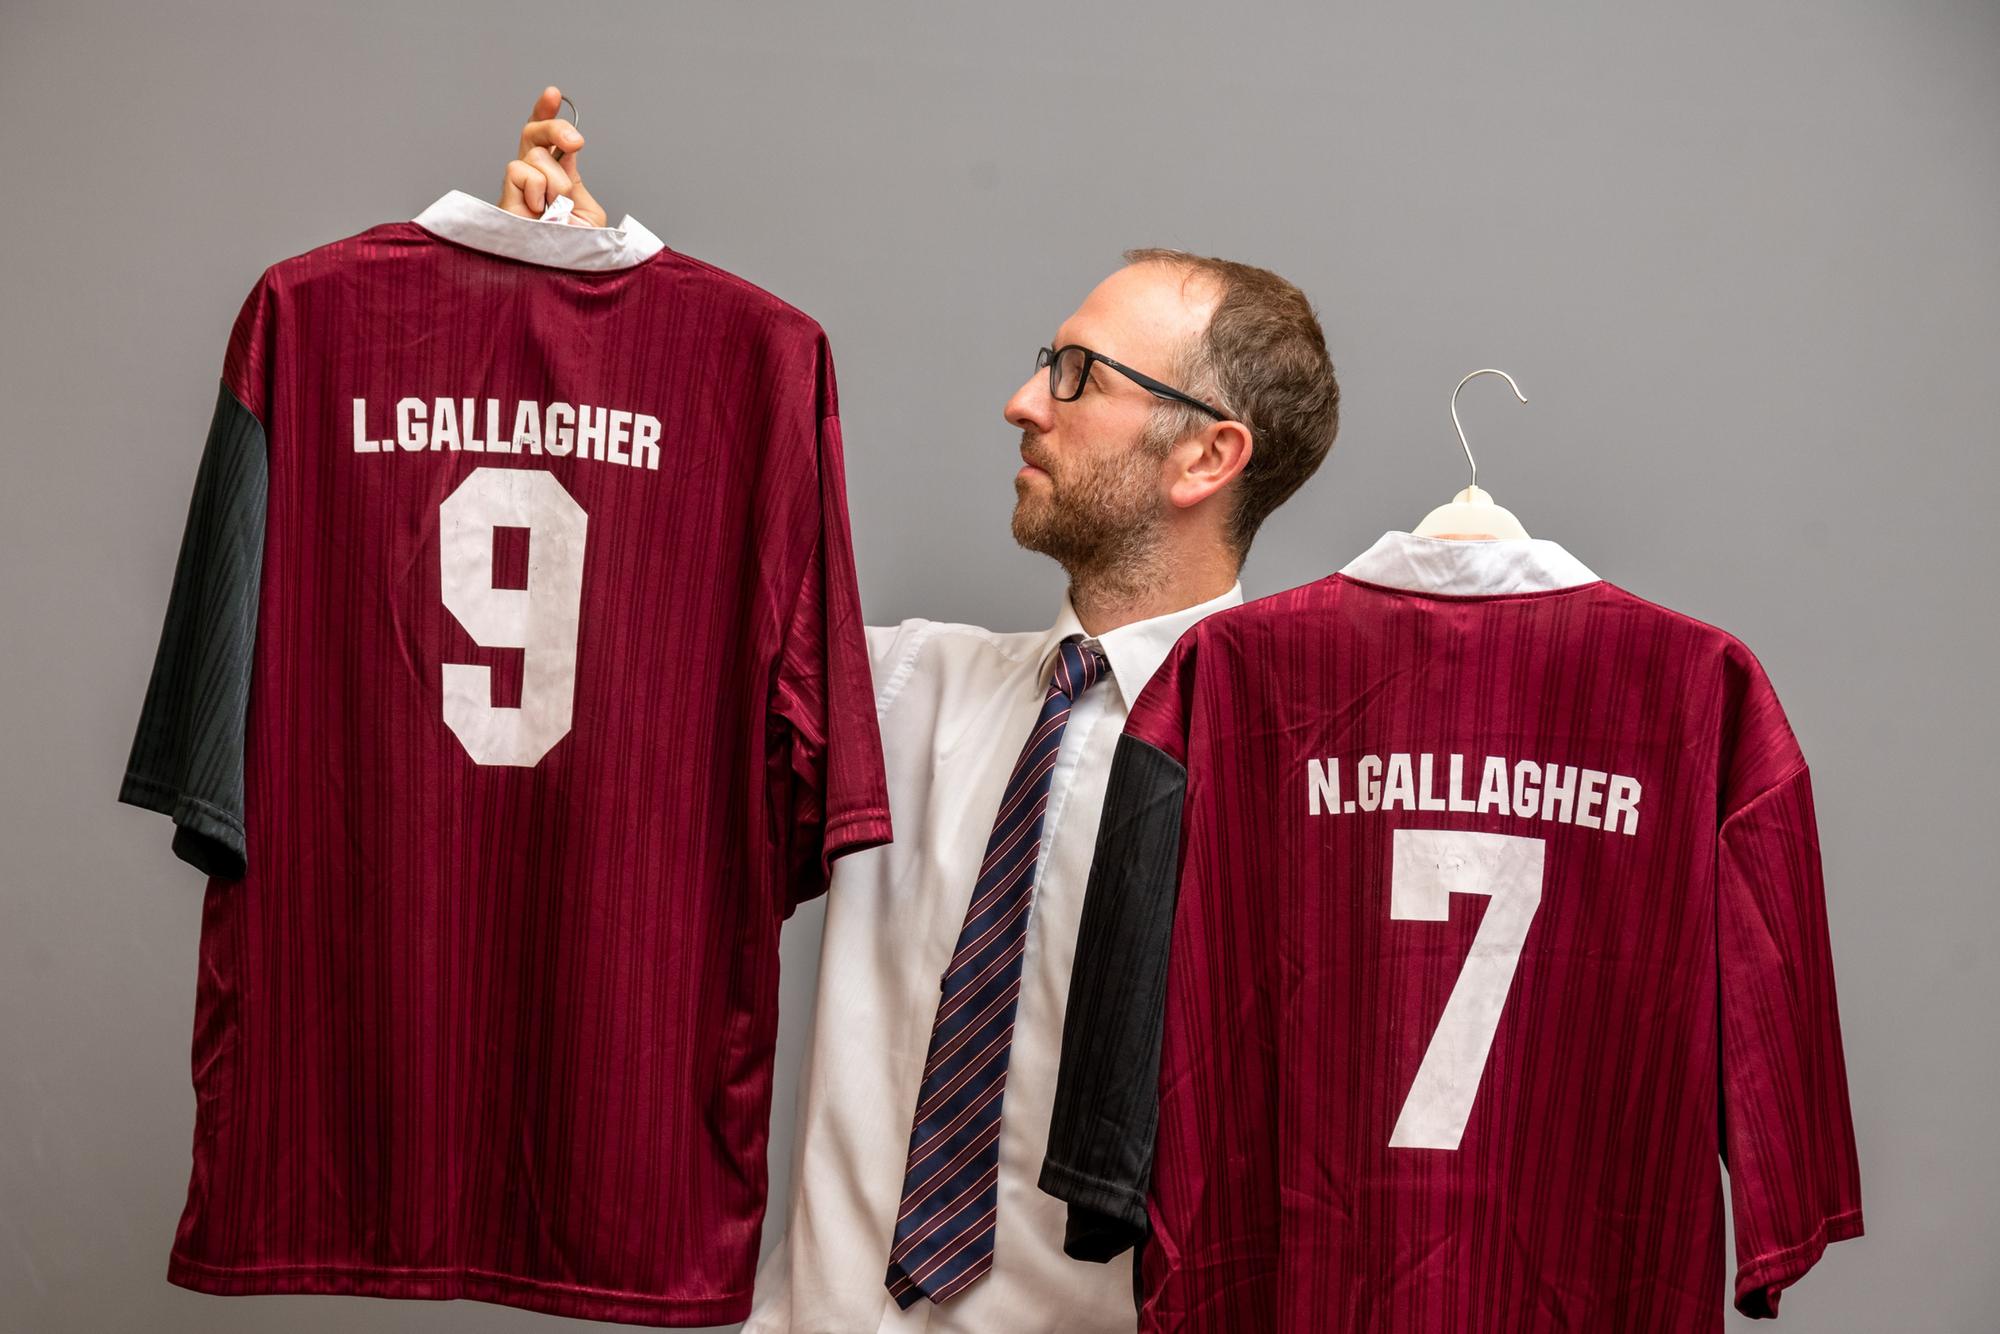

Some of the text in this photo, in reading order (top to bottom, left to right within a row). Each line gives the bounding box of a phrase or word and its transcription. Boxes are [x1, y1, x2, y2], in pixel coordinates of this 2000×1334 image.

[353, 397, 662, 471] L.GALLAGHER
[439, 467, 589, 768] 9
[1308, 753, 1642, 836] N.GALLAGHER
[1388, 829, 1546, 1151] 7
